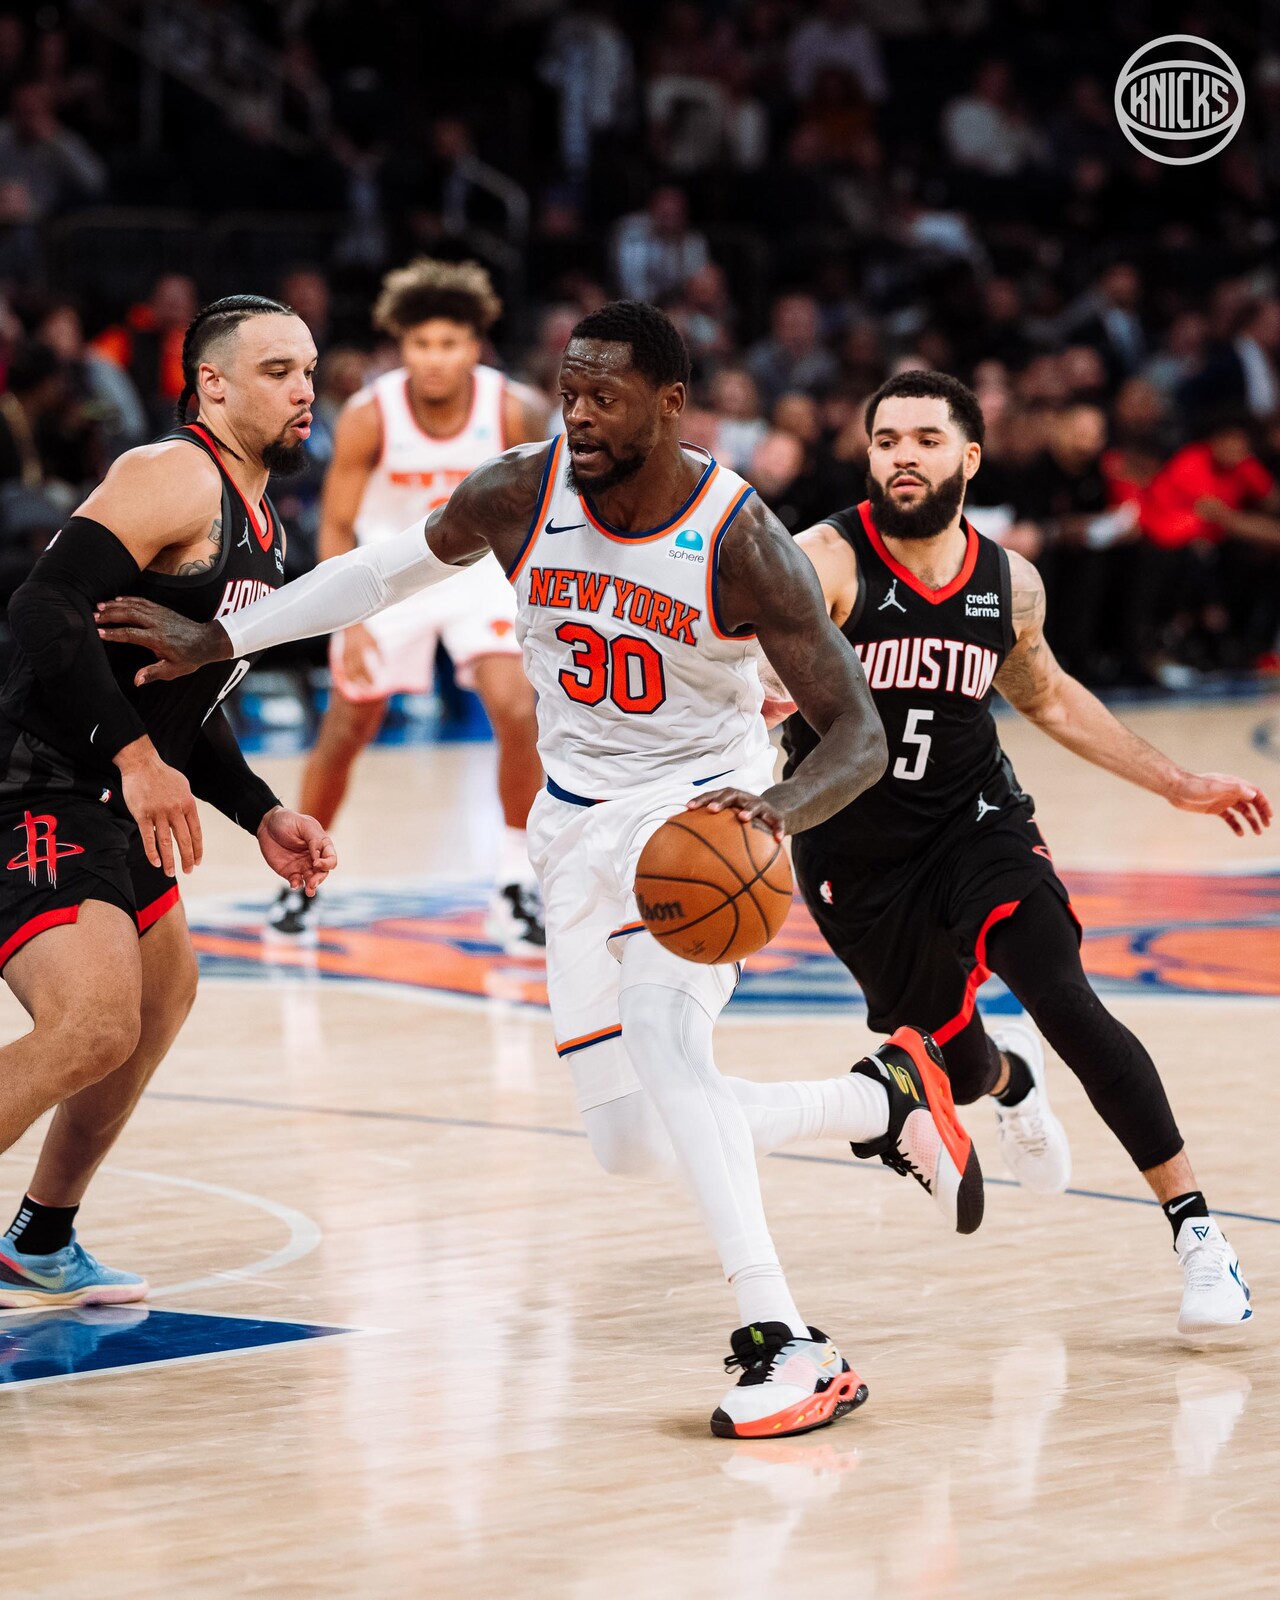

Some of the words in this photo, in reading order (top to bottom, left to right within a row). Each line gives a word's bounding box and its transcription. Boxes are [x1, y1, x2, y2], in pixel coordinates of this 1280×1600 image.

[668, 549, 705, 563] sphere
[528, 567, 611, 614] NEW
[612, 575, 702, 647] YORK
[965, 603, 1000, 617] karma
[966, 592, 999, 605] credit
[555, 621, 667, 715] 30
[854, 637, 998, 700] HOUSTON
[893, 708, 934, 781] 5
